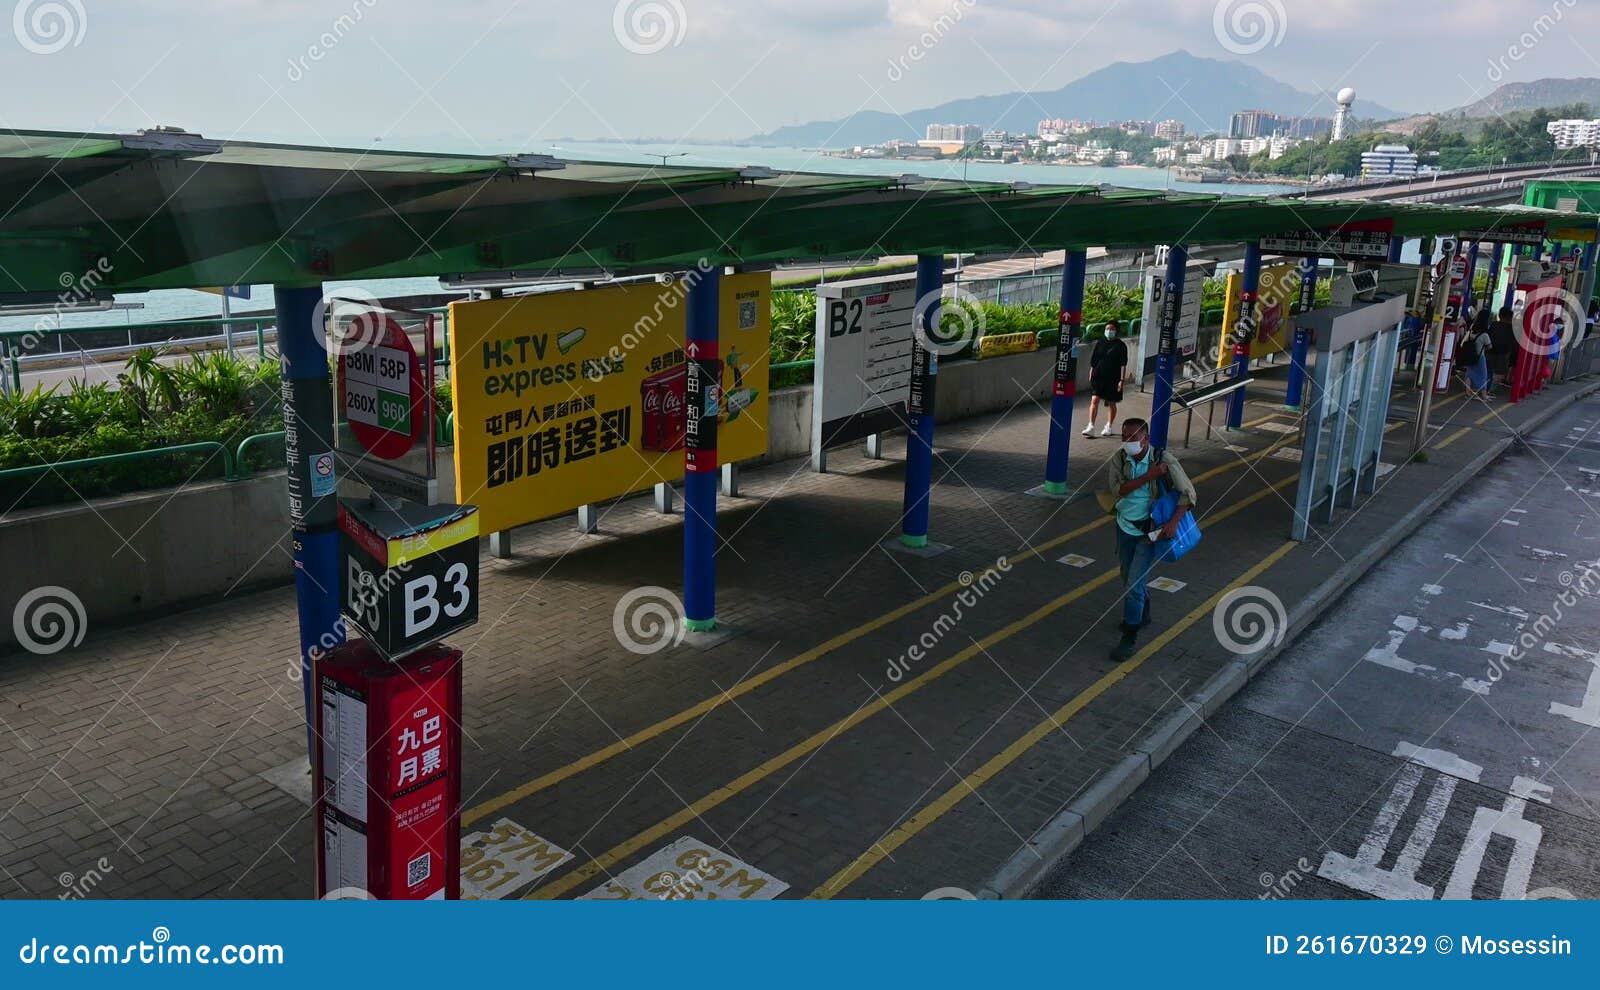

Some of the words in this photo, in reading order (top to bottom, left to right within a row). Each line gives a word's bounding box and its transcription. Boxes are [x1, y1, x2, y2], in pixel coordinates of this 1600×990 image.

[830, 298, 863, 338] B2
[346, 350, 375, 375] 58M
[380, 357, 406, 380] 58P
[483, 333, 548, 369] HKTV
[484, 362, 577, 398] express
[347, 391, 376, 415] 260X
[382, 400, 405, 422] 960
[487, 406, 632, 488] 即時送到
[404, 562, 470, 638] B3
[397, 715, 442, 756] 九巴
[397, 745, 441, 787] 月票
[481, 823, 566, 873] 57M
